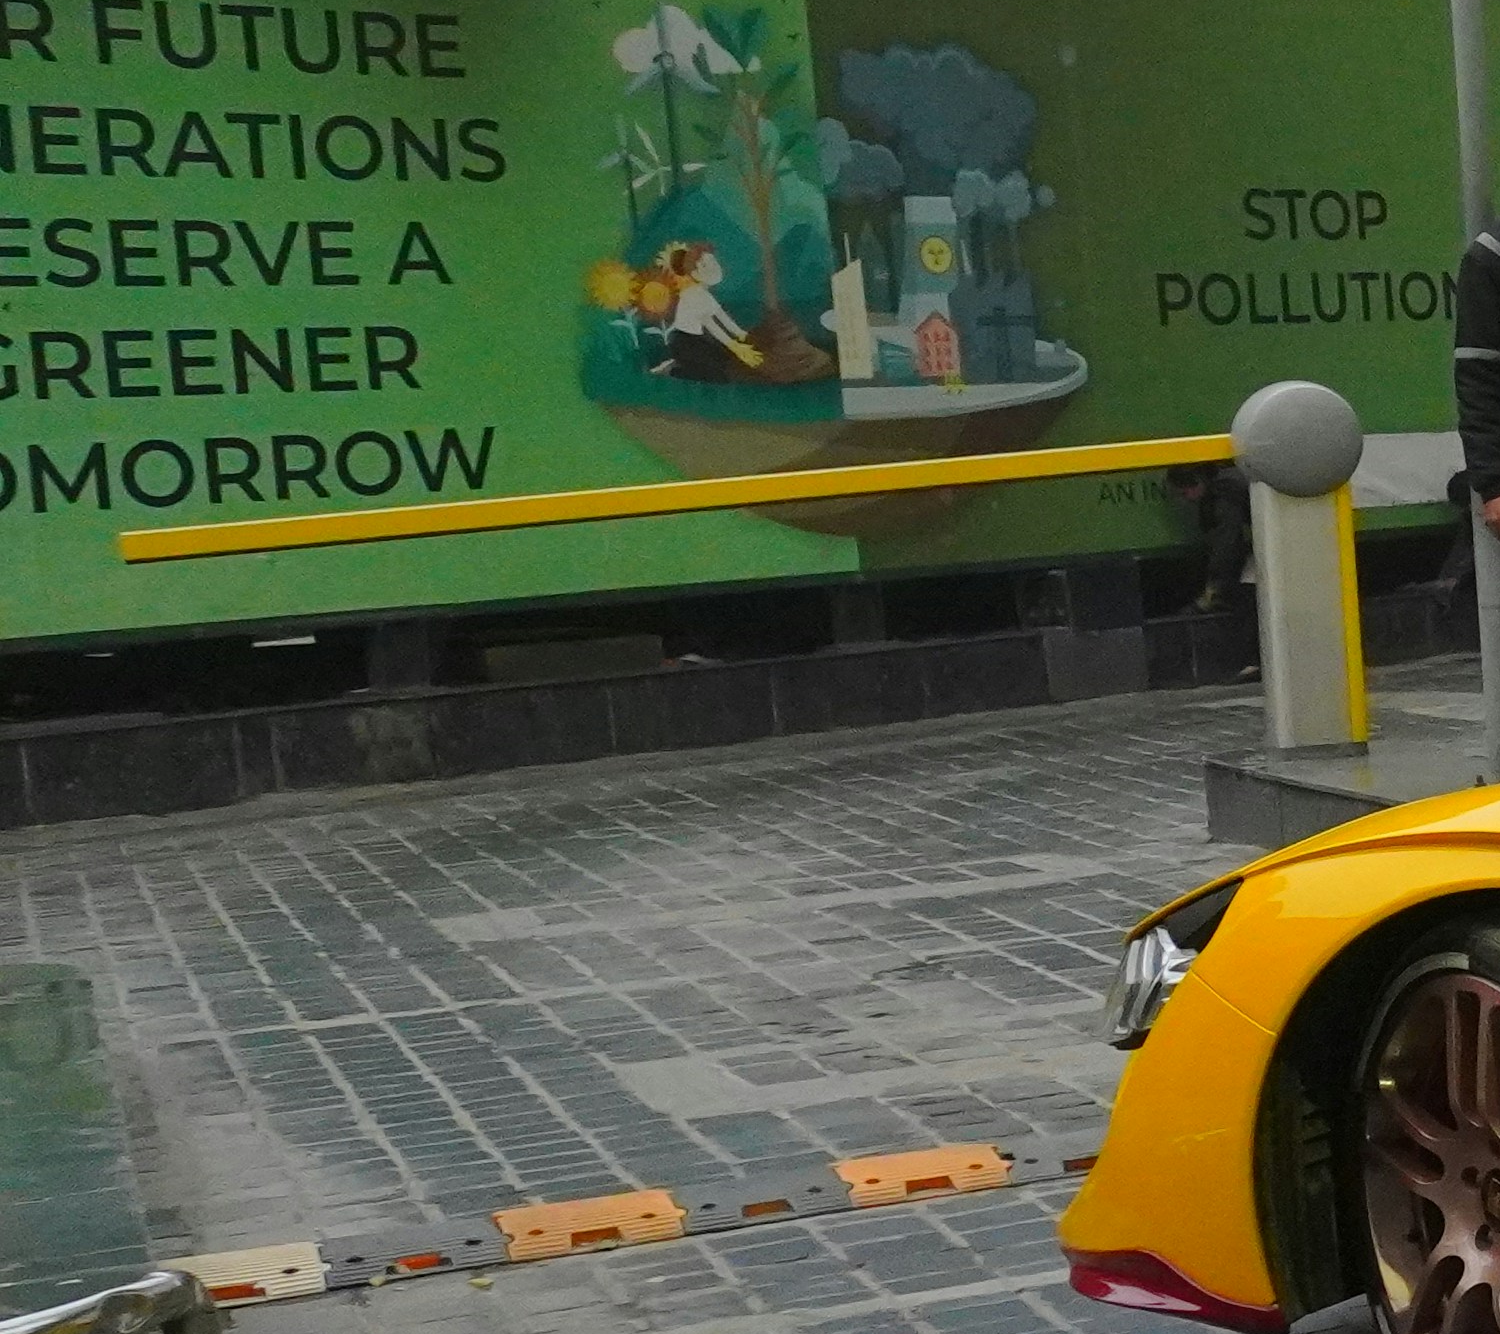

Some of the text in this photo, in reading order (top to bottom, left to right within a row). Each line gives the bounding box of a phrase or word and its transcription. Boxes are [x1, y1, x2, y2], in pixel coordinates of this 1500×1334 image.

[1242, 187, 1389, 242] STOP
[388, 221, 454, 285] A
[0, 426, 497, 514] MORROW
